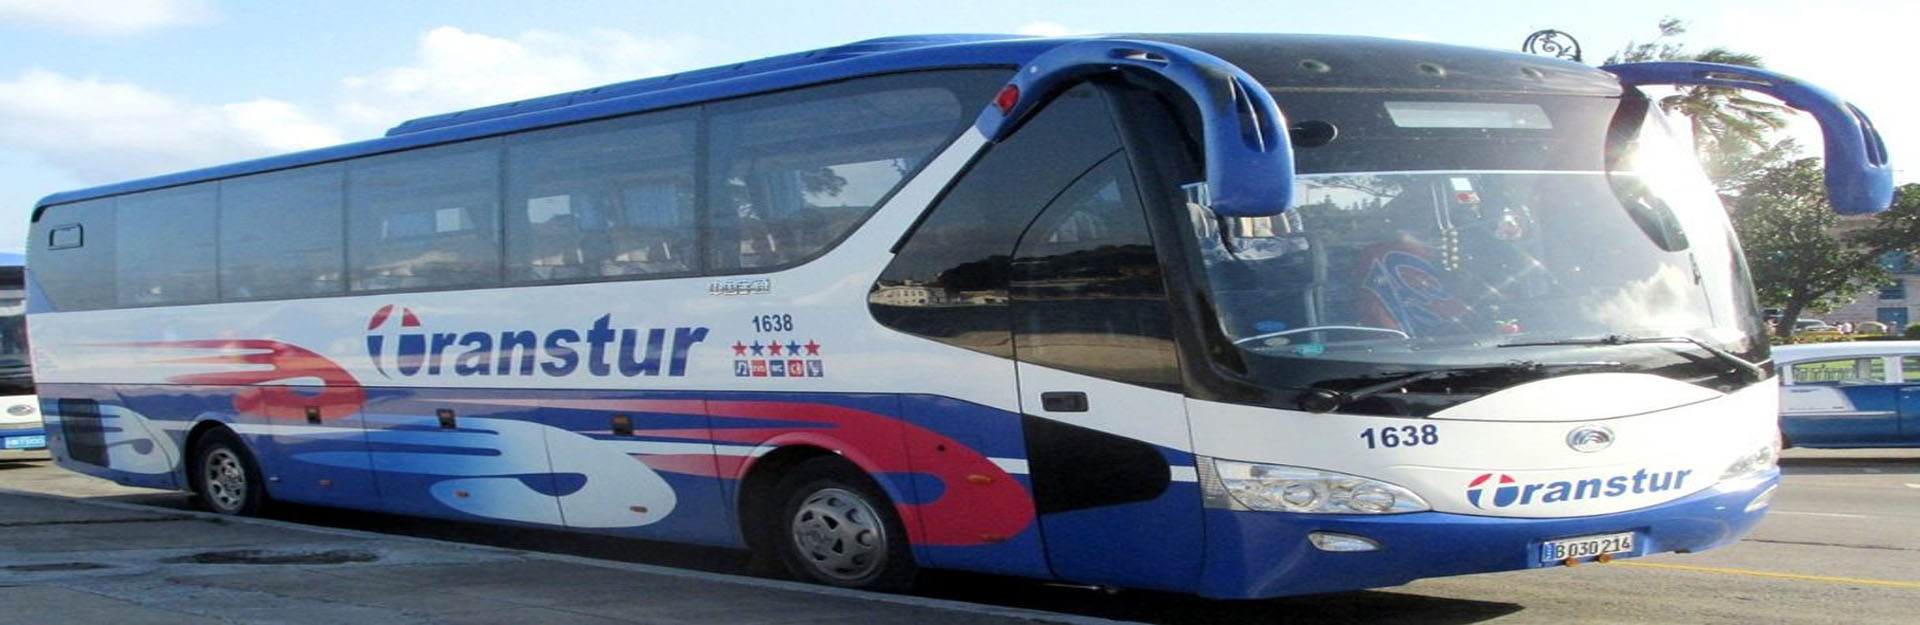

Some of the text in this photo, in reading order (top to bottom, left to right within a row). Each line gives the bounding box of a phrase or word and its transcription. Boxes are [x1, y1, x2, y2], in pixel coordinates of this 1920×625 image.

[752, 313, 794, 333] 1638
[1360, 423, 1439, 449] 1638
[1555, 544, 1566, 559] B
[1568, 540, 1599, 557] 030
